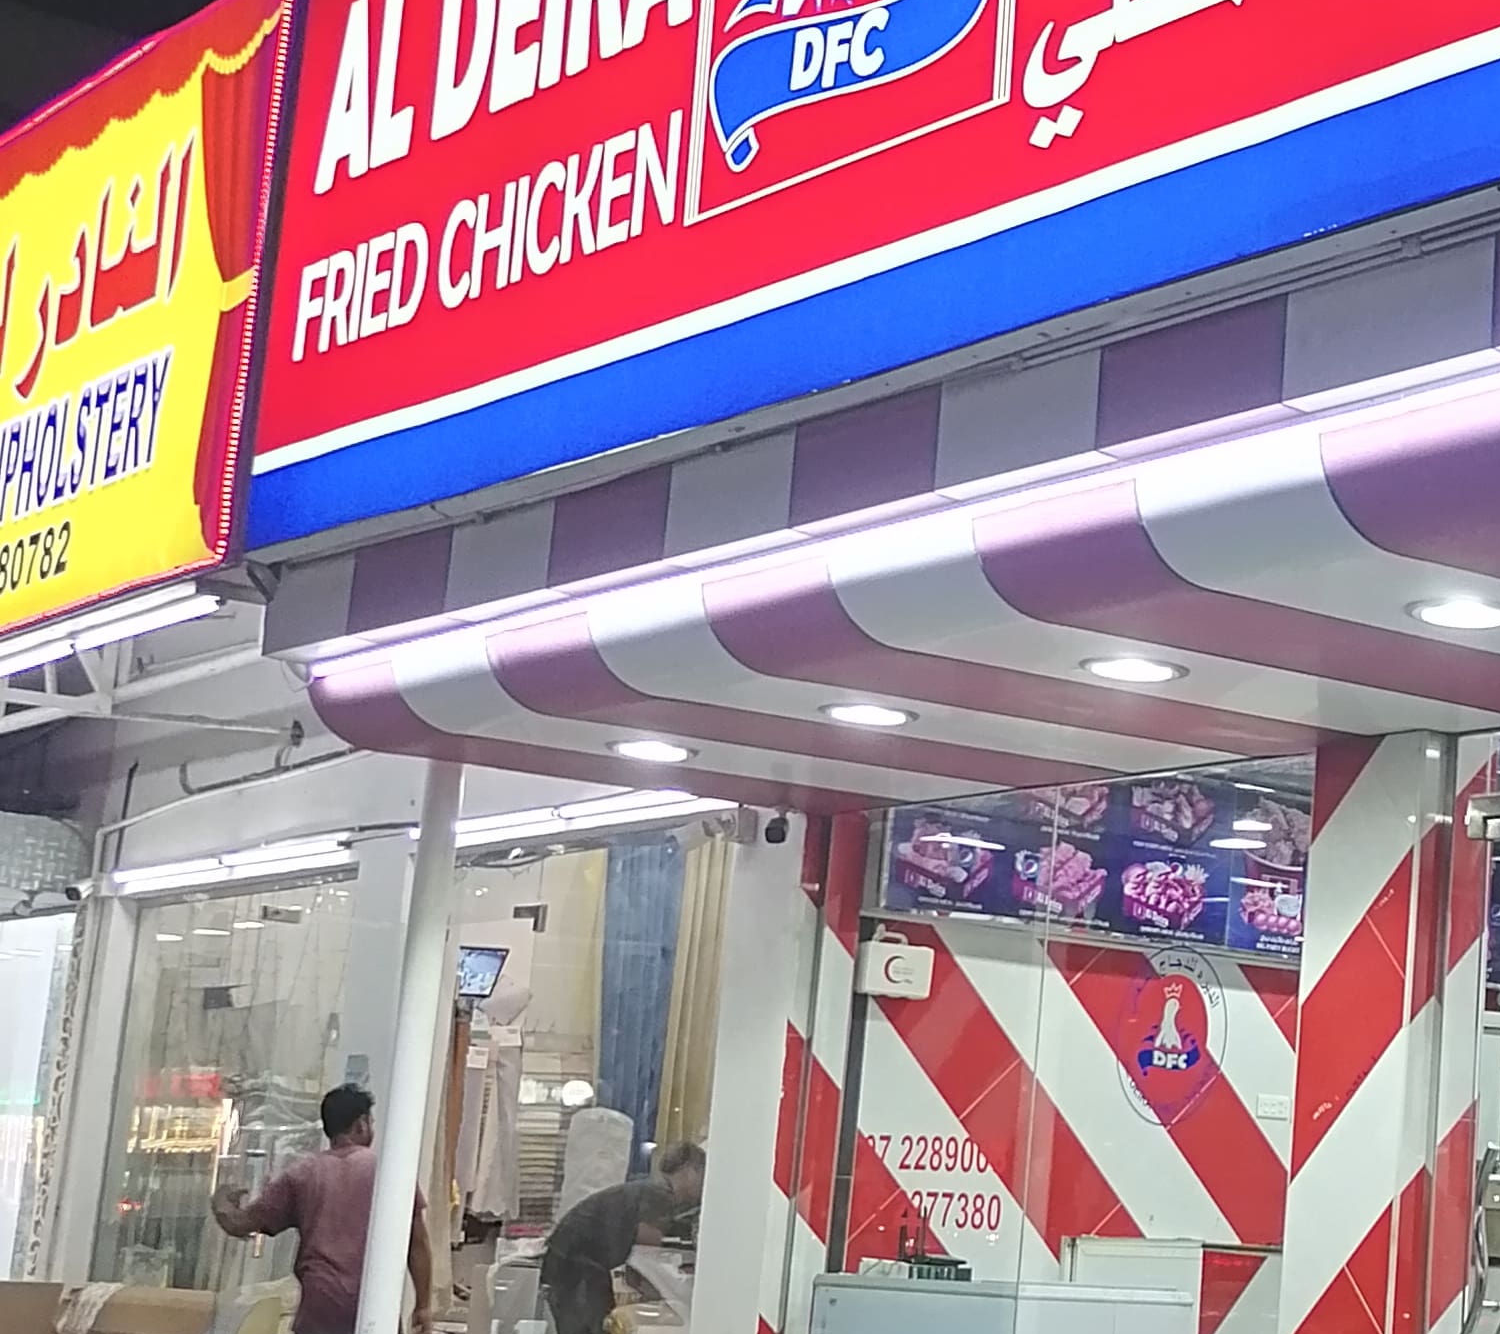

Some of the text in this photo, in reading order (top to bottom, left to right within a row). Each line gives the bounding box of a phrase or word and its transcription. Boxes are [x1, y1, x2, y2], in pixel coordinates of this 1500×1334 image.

[789, 7, 891, 93] DFC
[291, 110, 684, 362] FRIED CHICKEN
[0, 351, 173, 524] PHOLSTERY
[1152, 1050, 1188, 1069] DFC
